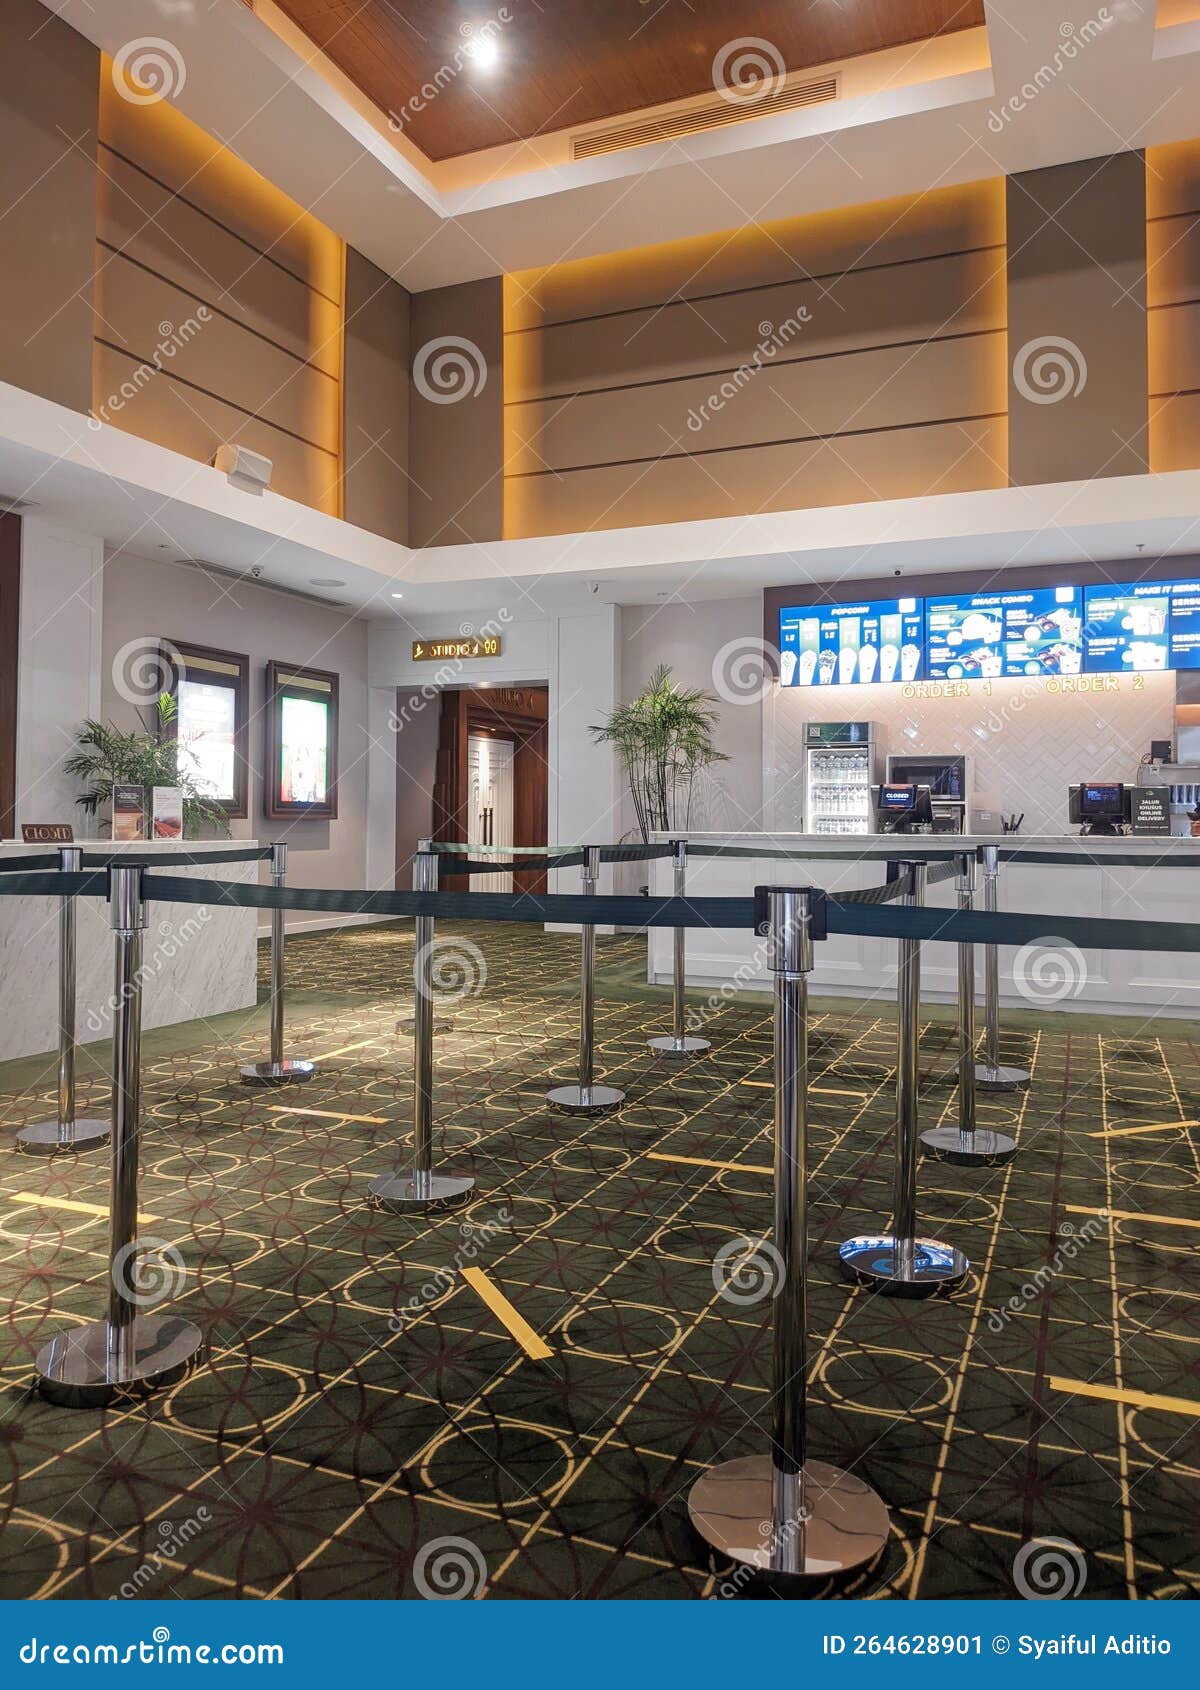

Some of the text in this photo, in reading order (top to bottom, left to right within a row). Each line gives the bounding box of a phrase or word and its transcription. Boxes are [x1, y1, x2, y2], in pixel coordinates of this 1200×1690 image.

[831, 606, 870, 616] POPCORN
[429, 643, 470, 657] STUDIO
[901, 682, 993, 699] ORDER 1
[1046, 675, 1145, 694] ORDER 2
[24, 826, 71, 840] CLOSED
